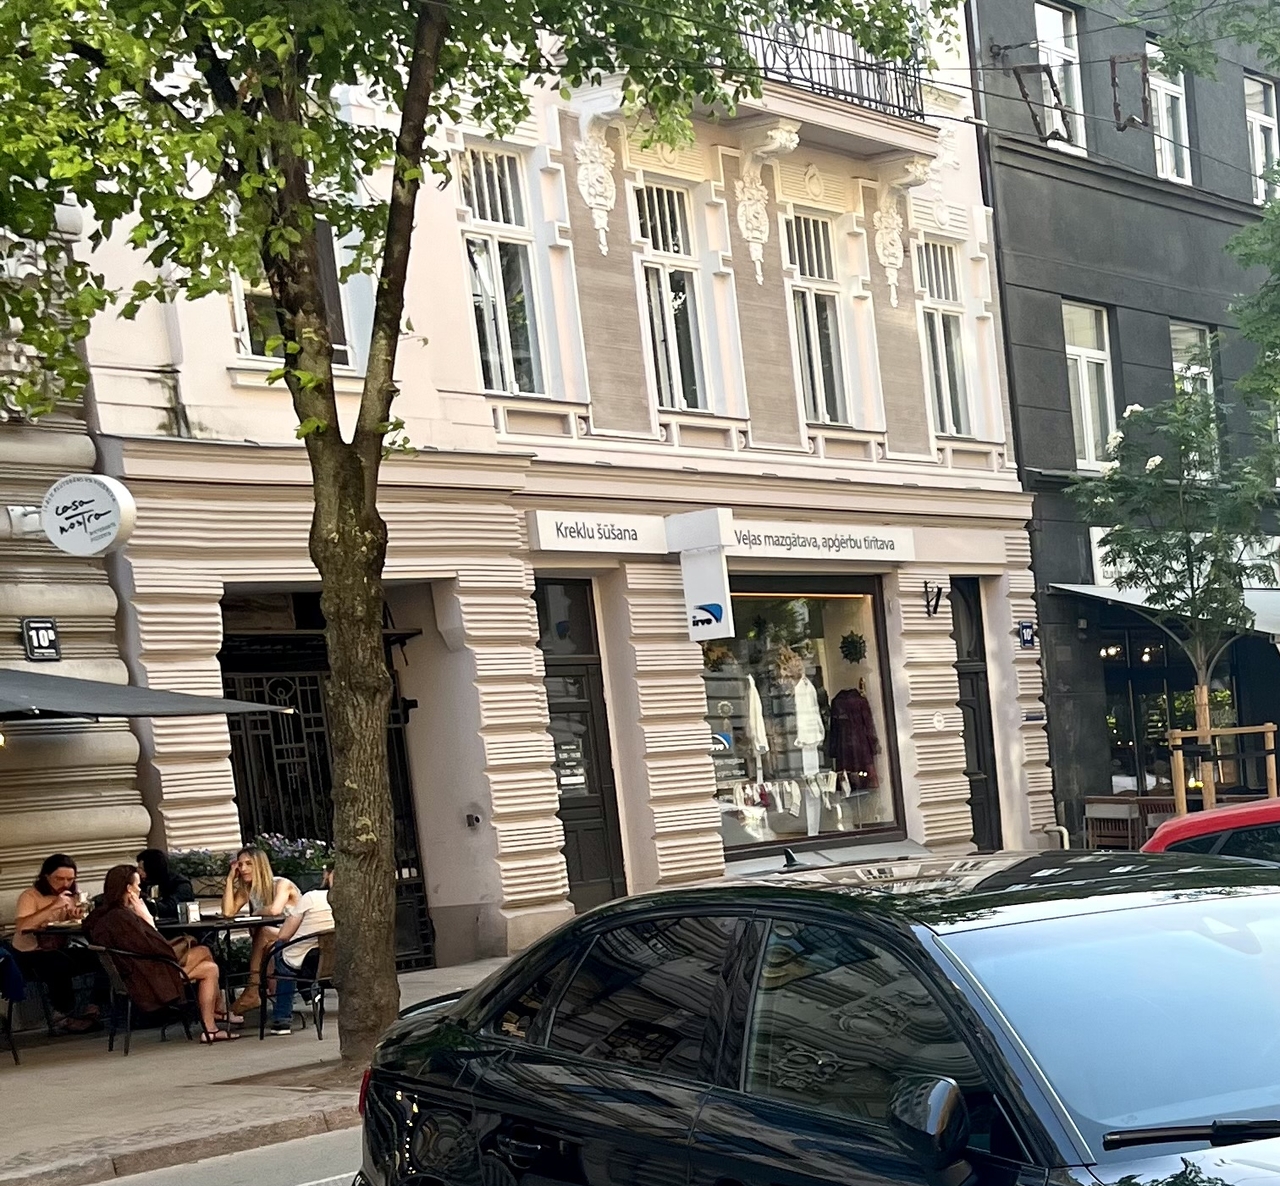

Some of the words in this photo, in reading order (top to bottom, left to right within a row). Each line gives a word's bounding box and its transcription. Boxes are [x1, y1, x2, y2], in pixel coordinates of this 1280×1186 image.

[56, 499, 95, 516] casa
[59, 509, 112, 535] nostra
[555, 521, 595, 540] Kreklu
[597, 523, 638, 541] šūšana
[734, 529, 762, 549] Veļas
[764, 533, 821, 550] mazgātava,
[822, 534, 862, 553] apģērbu
[864, 536, 895, 551] tīrītava
[692, 615, 713, 627] irve
